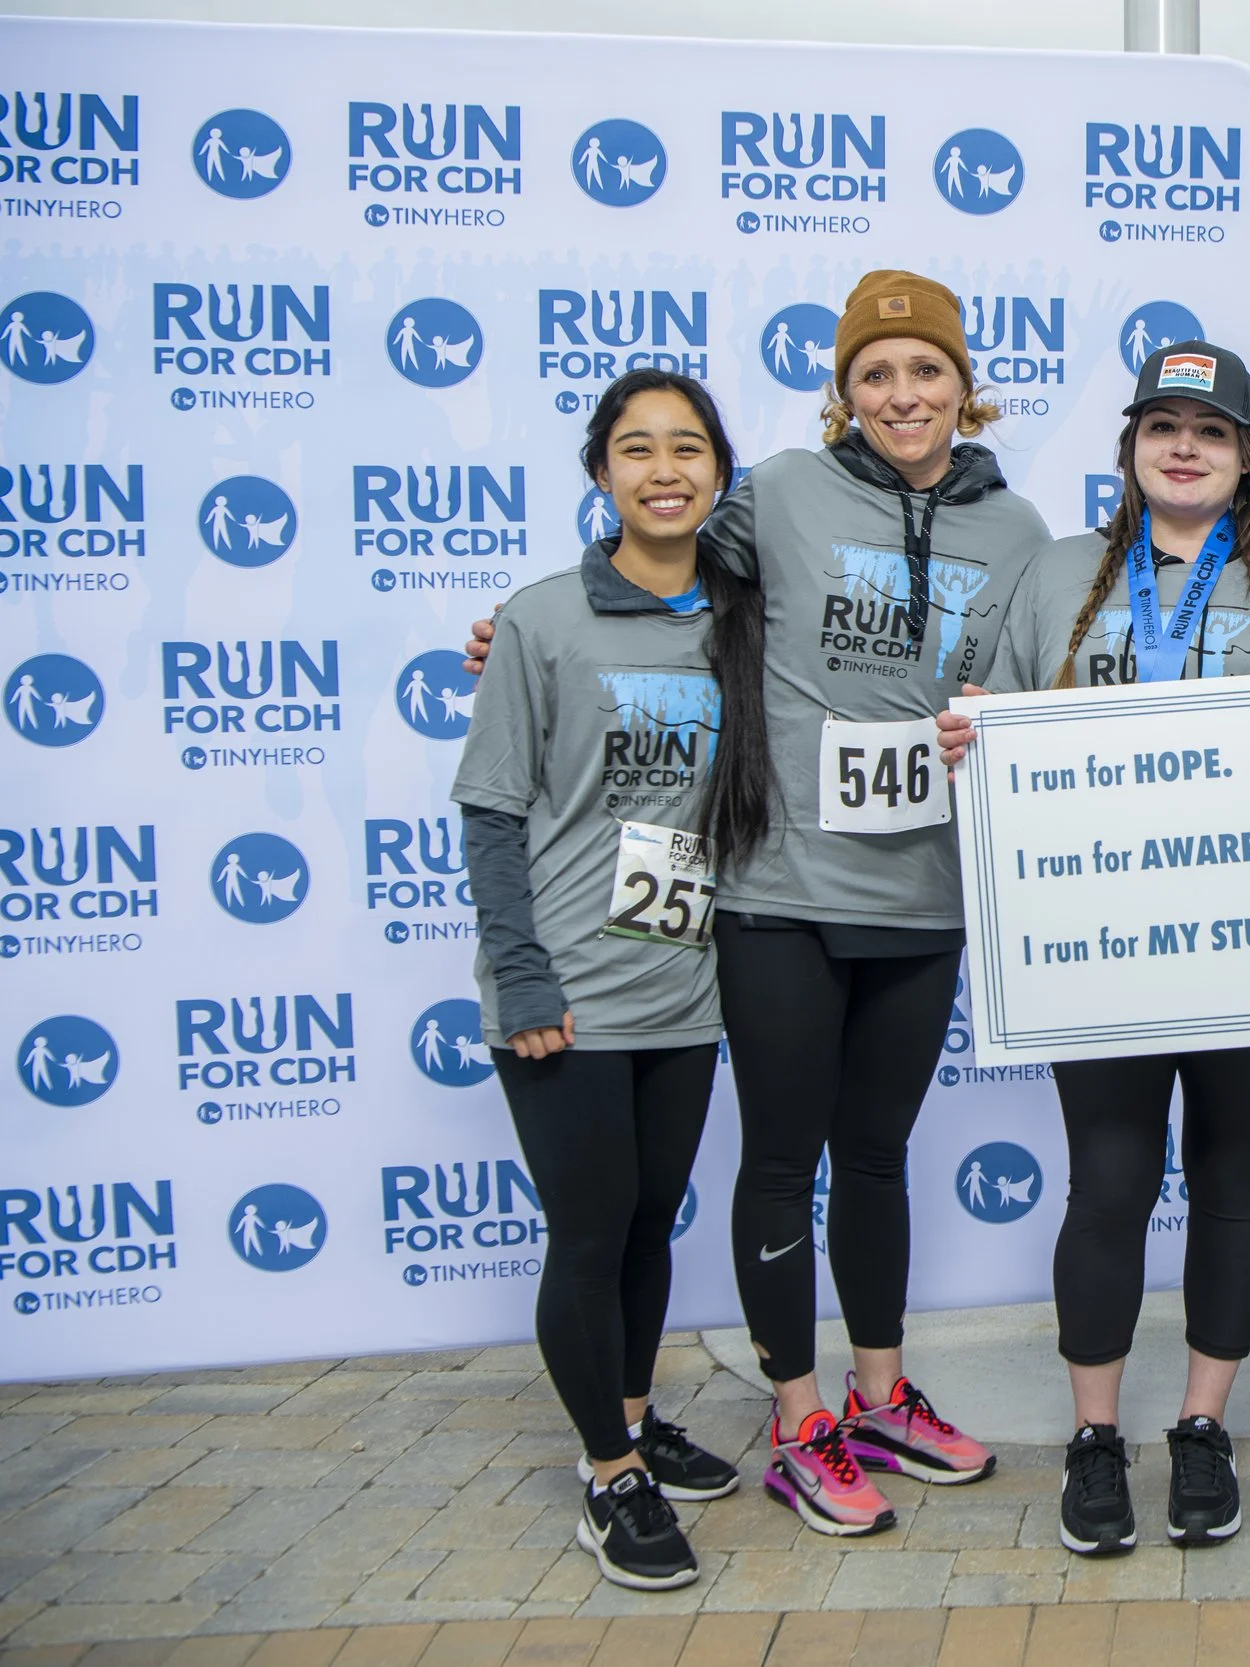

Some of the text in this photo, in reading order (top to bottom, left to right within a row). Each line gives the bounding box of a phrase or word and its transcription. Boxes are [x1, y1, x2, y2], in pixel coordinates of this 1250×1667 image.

[349, 102, 520, 161] RUN
[722, 111, 885, 169] RUN
[1086, 122, 1241, 180] RUN
[51, 156, 138, 185] CDH
[349, 164, 521, 194] FOR CDH
[722, 173, 885, 202] FOR CDH
[1086, 182, 1240, 212] FOR CDH
[3, 198, 122, 218] TINYHERO
[392, 208, 504, 226] TINYHERO
[763, 215, 870, 233] TINYHERO
[1125, 224, 1224, 243] TINYHERO
[153, 283, 329, 342] RUN
[539, 289, 707, 347] RUN
[957, 296, 1064, 352] UN
[154, 347, 330, 375] FOR CDH
[540, 351, 617, 379] FOR
[987, 357, 1064, 384] CDH
[199, 391, 314, 409] TINYHERO
[353, 465, 525, 523] RUN
[58, 529, 145, 557] CDH
[355, 528, 526, 556] FOR CDH
[11, 573, 129, 591] TINYHERO
[399, 571, 512, 590] TINYHERO
[1171, 553, 1219, 640] RUN FOR CDH
[1140, 598, 1156, 645] TINYHERO
[820, 631, 923, 662] FOR CDH
[957, 635, 979, 683] 2023
[162, 640, 339, 699] RUN
[842, 660, 908, 679] TINYHERO
[164, 704, 340, 733] FOR CDH
[209, 747, 325, 766] TINYHERO
[604, 730, 697, 767] RUN
[601, 769, 694, 788] FOR CDH
[839, 743, 930, 808] 546
[1010, 748, 1233, 793] I run for HOPE.
[365, 818, 468, 875] RU
[1017, 849, 1025, 880] I
[1037, 853, 1082, 878] run
[1092, 840, 1132, 874] for
[0, 889, 158, 921] OR CDH
[367, 881, 446, 909] FOR
[24, 933, 142, 954] TINYHERO
[1023, 935, 1032, 966] I
[1044, 939, 1089, 964] run
[1099, 926, 1139, 960] for
[1148, 921, 1200, 956] MY
[176, 993, 353, 1056] RUN
[179, 1056, 355, 1090] FOR CDH
[225, 1099, 340, 1120] TINYHERO
[0, 1180, 174, 1246] RUN
[385, 1224, 464, 1254] FOR
[0, 1242, 176, 1280] FOR CDH
[430, 1259, 541, 1282] TINYHERO
[43, 1285, 162, 1310] TINYHERO
